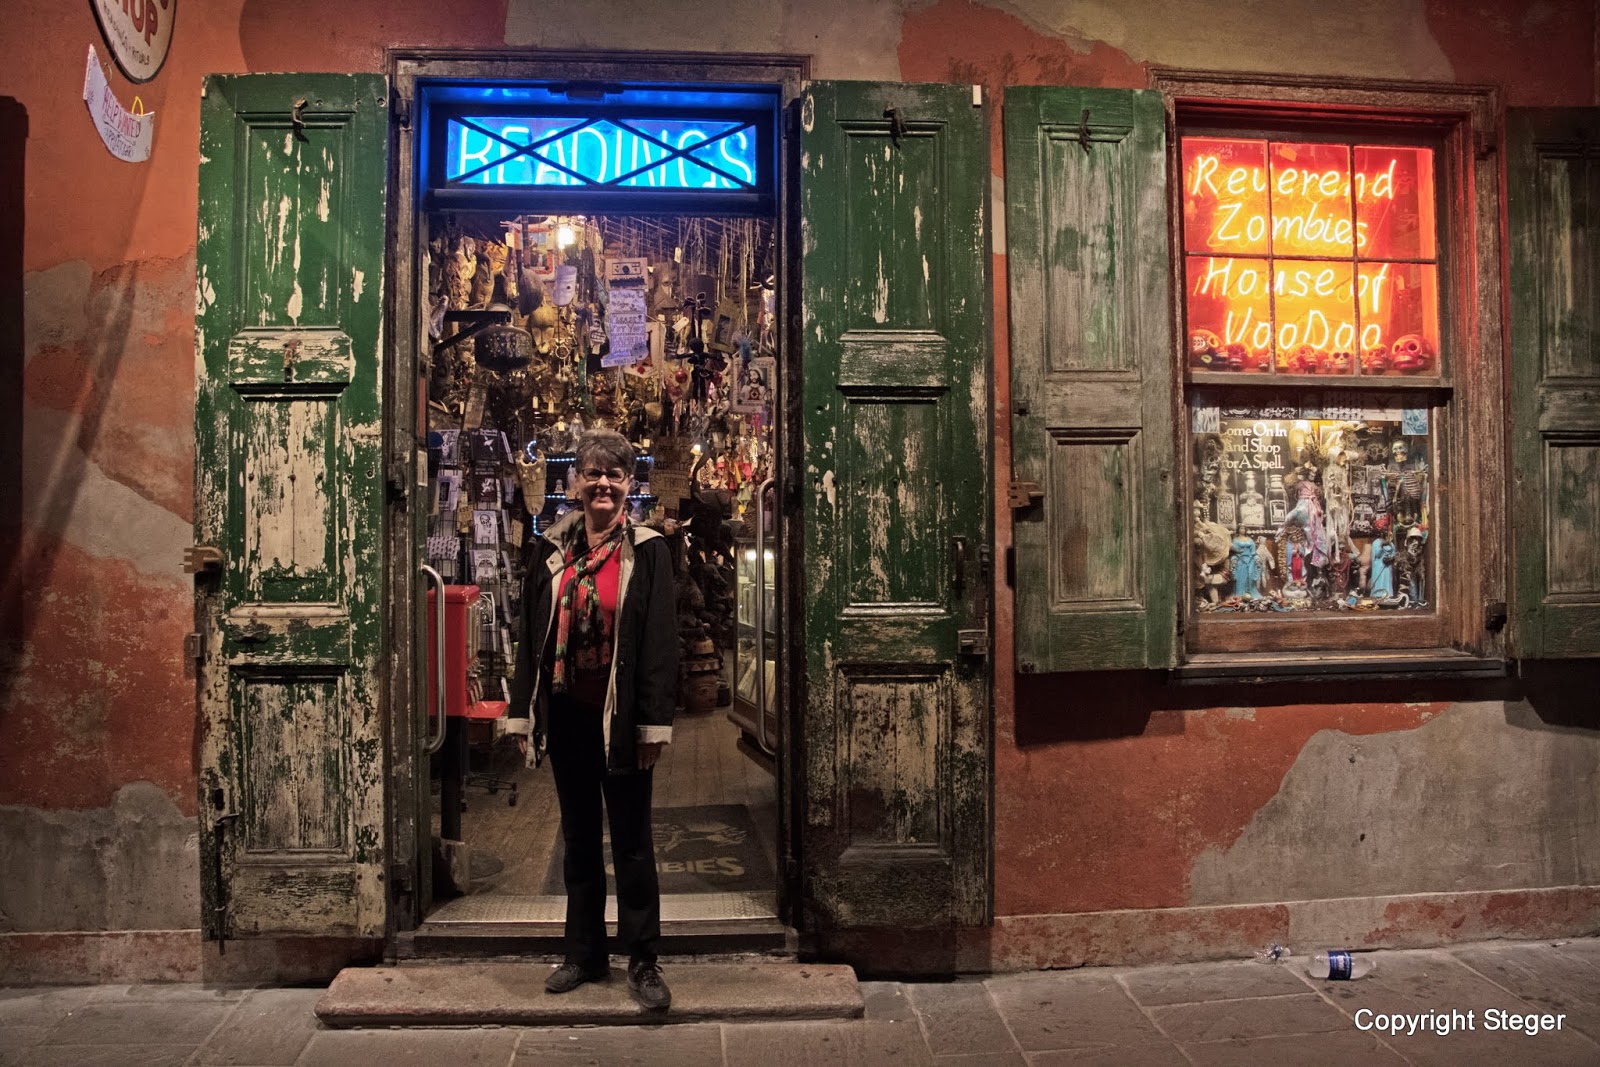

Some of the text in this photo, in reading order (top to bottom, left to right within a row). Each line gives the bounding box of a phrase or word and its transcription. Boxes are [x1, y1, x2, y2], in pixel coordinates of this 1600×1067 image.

[115, 0, 158, 47] OP
[103, 85, 119, 123] HELP
[458, 125, 753, 188] READINGS
[1191, 155, 1398, 200] Reverend
[1216, 202, 1369, 248] Zombies
[1200, 256, 1336, 297] House
[1350, 262, 1390, 314] of
[1225, 306, 1383, 350] VooDoo
[1219, 421, 1288, 437] Come On In
[1250, 437, 1281, 455] Shop
[1239, 453, 1252, 469] A
[1252, 453, 1285, 471] Spell.
[657, 857, 745, 876] BIES
